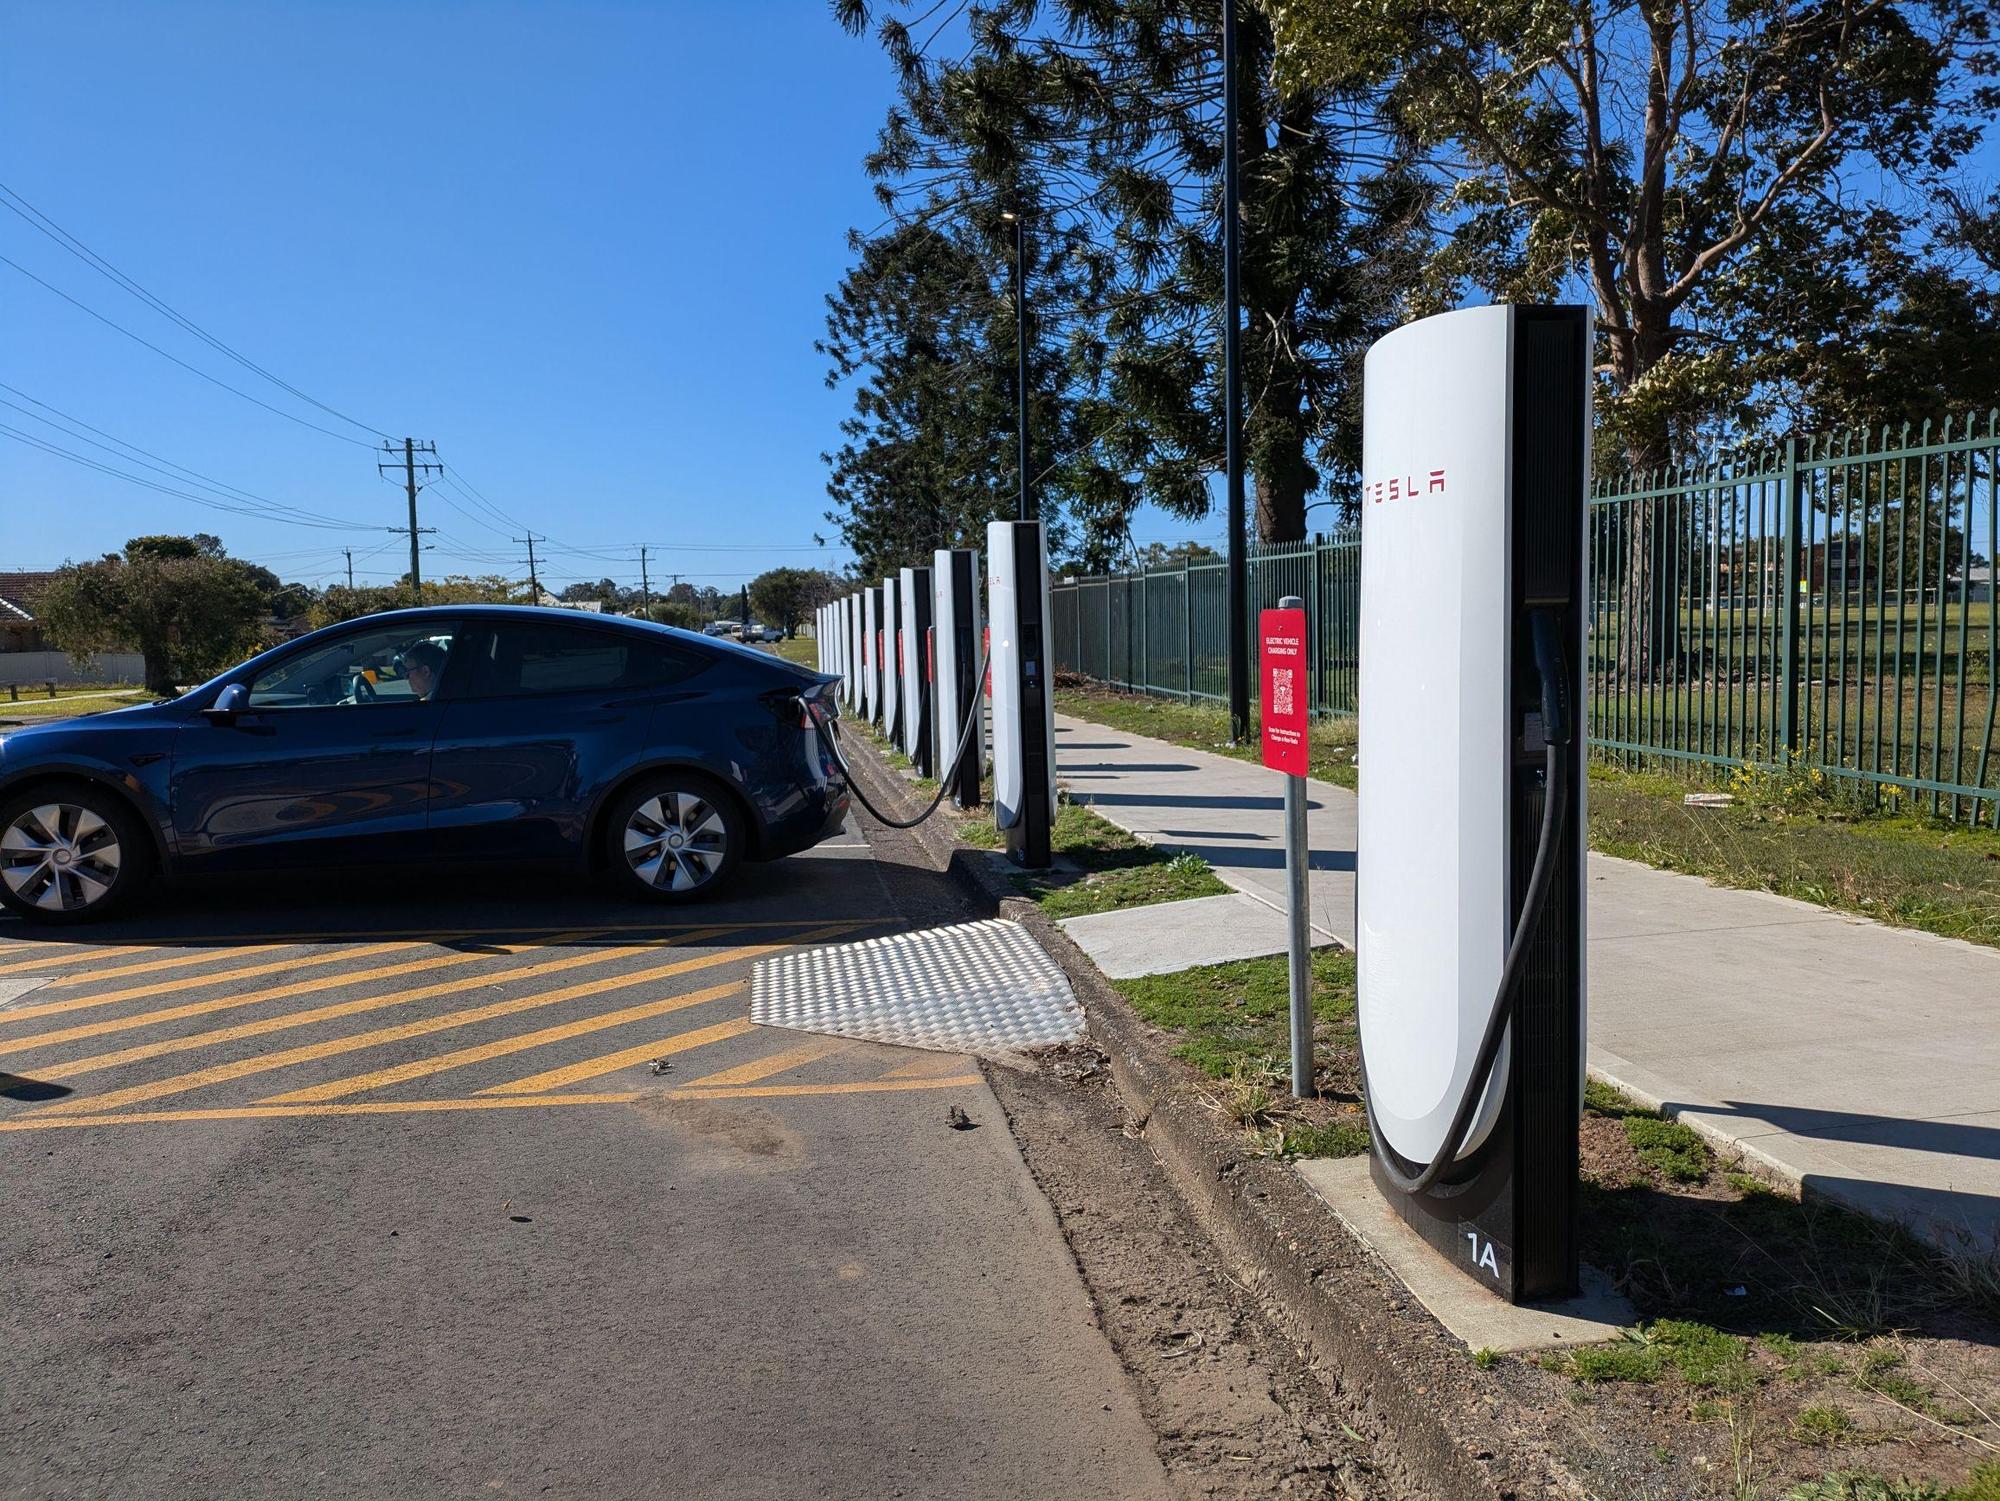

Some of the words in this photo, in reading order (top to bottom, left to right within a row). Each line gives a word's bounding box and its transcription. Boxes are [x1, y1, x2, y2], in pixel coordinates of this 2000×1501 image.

[1365, 470, 1445, 506] TESLA
[1266, 637, 1283, 645] ELECTRIC
[1467, 1232, 1500, 1279] 1A
